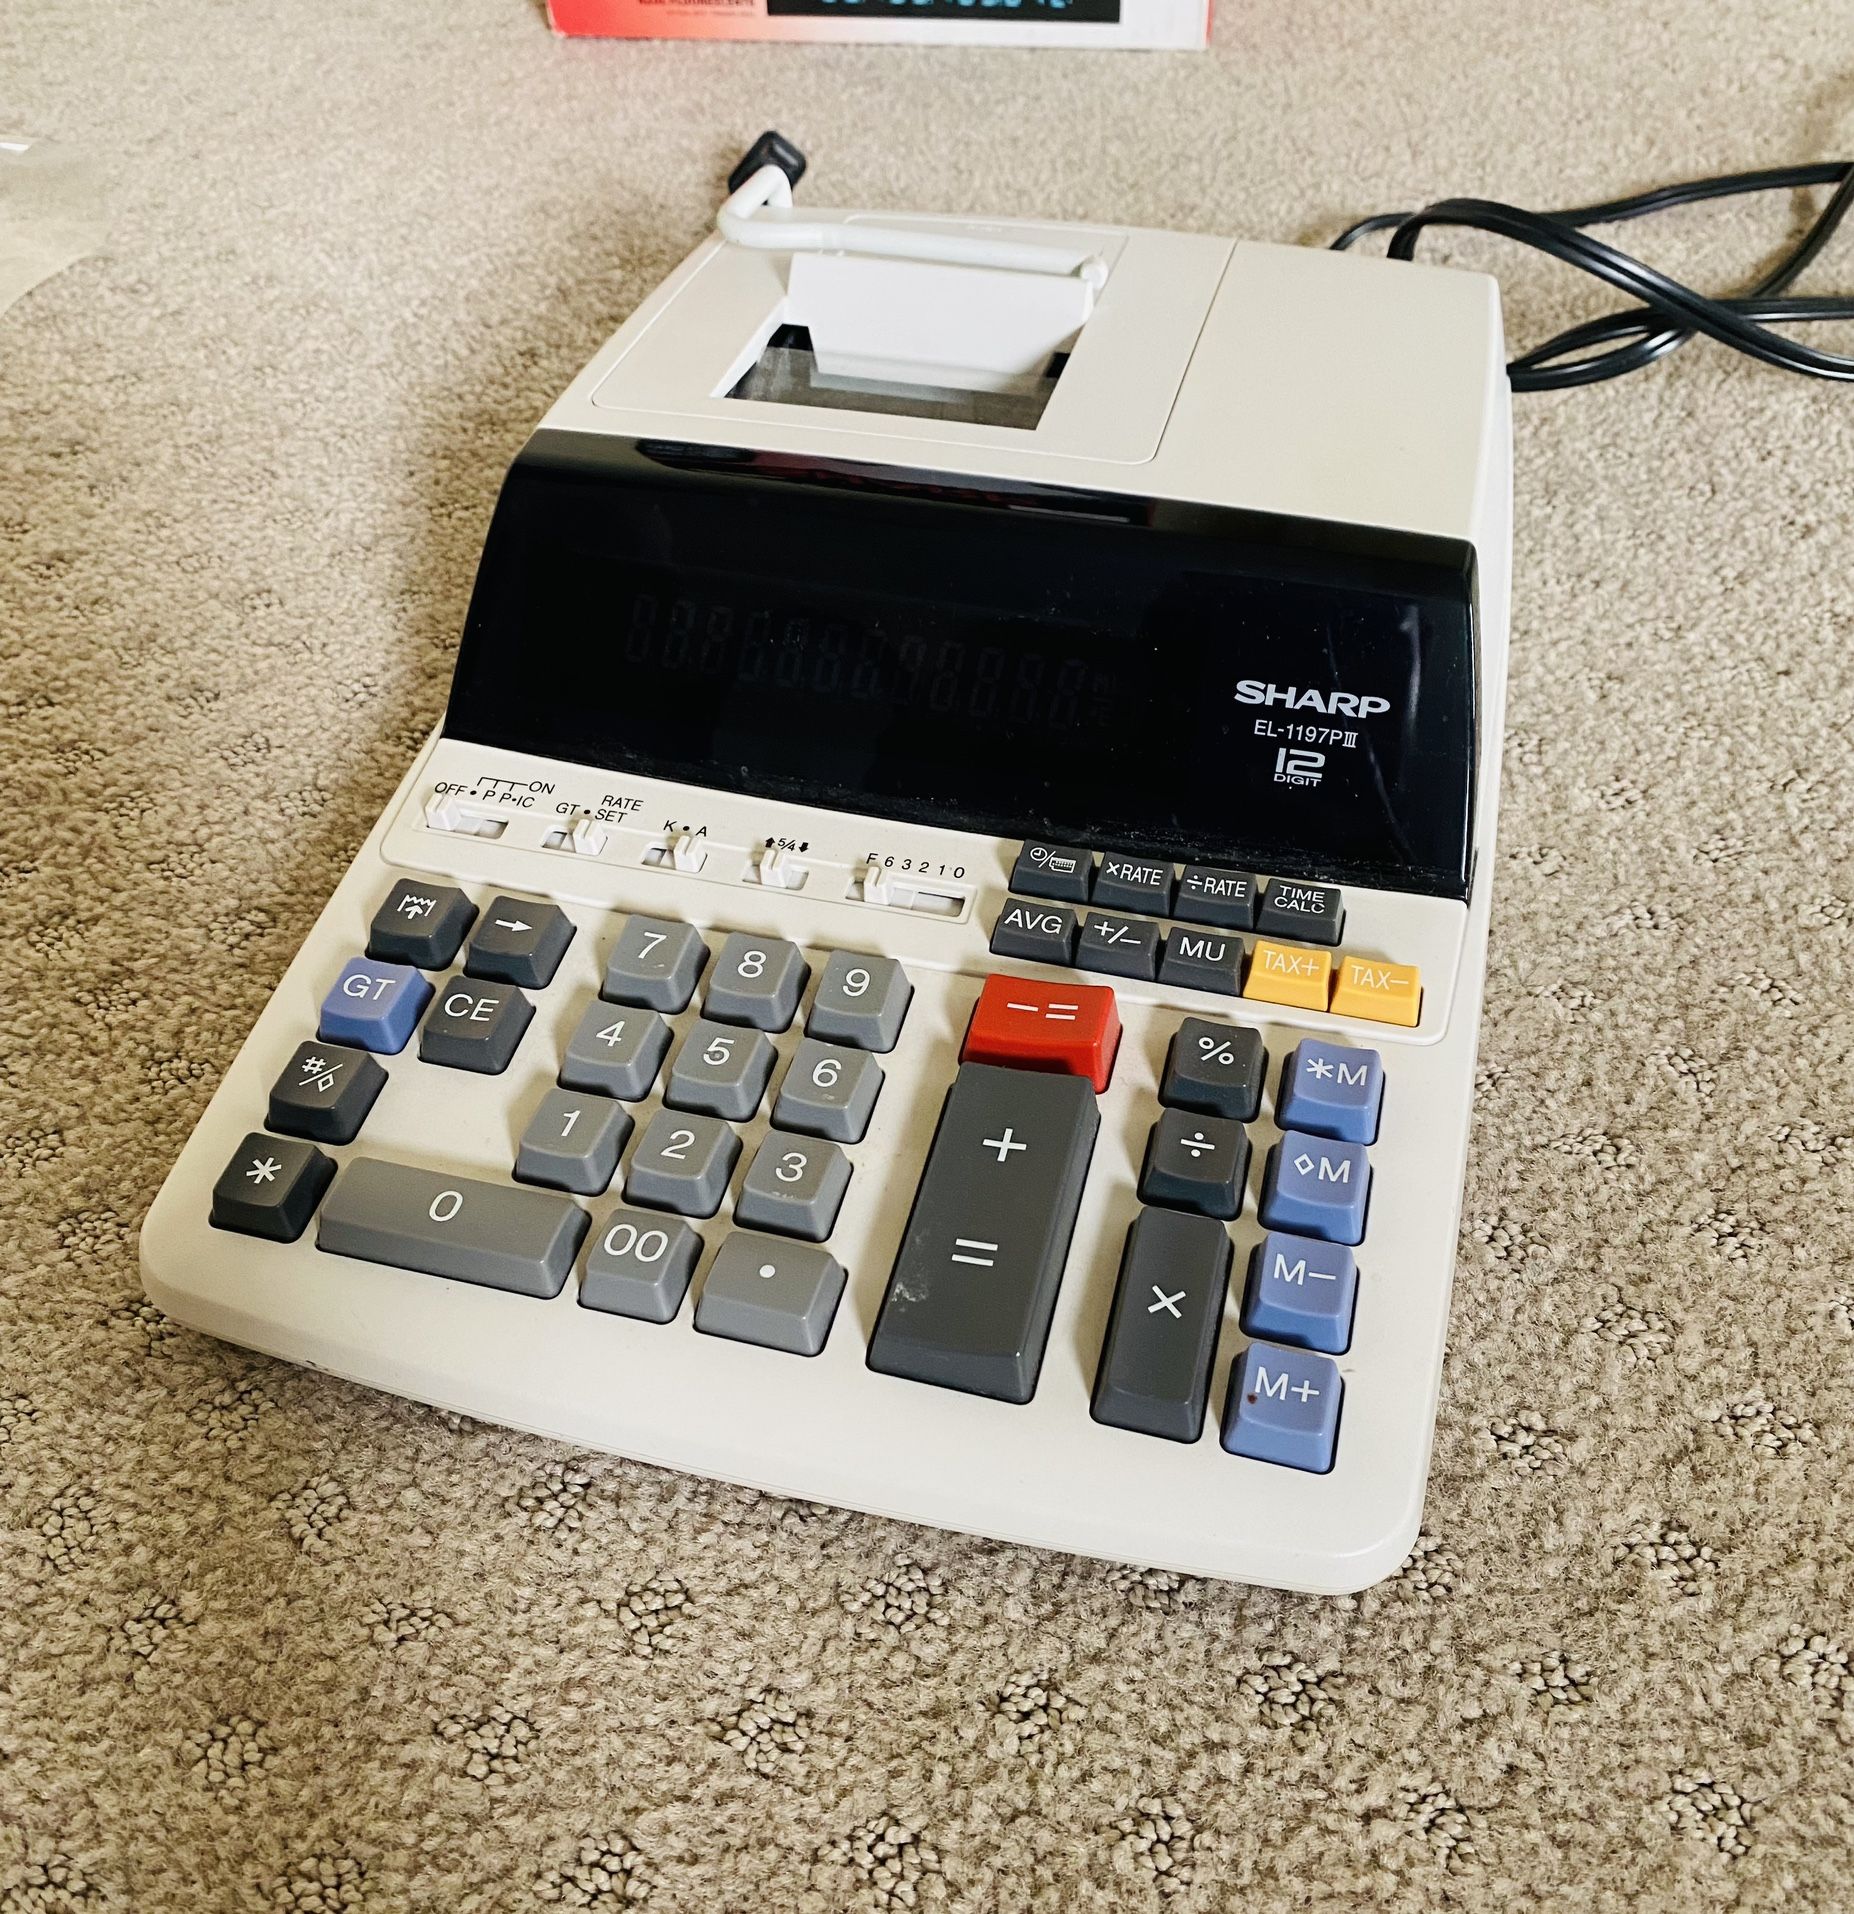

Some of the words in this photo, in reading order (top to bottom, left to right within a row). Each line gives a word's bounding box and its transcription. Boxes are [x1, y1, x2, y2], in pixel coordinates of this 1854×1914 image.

[1234, 680, 1391, 718] SHARP
[1275, 747, 1326, 778] 12
[434, 781, 468, 796] OFF
[528, 780, 556, 795] ON
[1273, 773, 1322, 787] DIGIT
[555, 802, 580, 816] GT
[594, 808, 628, 824] SET
[601, 794, 644, 812] RATE
[663, 820, 677, 832] K
[695, 825, 708, 837] A
[865, 852, 879, 865] F
[884, 855, 895, 868] 6
[901, 858, 912, 870] 3
[918, 861, 930, 873] 2
[1274, 895, 1325, 914] CALC
[1279, 885, 1325, 903] TIME
[1004, 908, 1063, 935] AVG
[638, 932, 667, 959] 7
[1179, 937, 1226, 962] MU
[737, 950, 767, 978] 8
[1263, 949, 1320, 978] TAX+
[342, 974, 396, 1001] GT
[842, 968, 871, 997] 9
[444, 993, 500, 1022] CE
[595, 1020, 626, 1047] 4
[702, 1037, 735, 1065] 5
[1198, 1036, 1234, 1065] %
[811, 1058, 842, 1087] 6
[560, 1110, 582, 1137] 1
[660, 1130, 696, 1160] 2
[775, 1152, 807, 1182] 3
[428, 1190, 464, 1222] 0
[1254, 1366, 1320, 1403] M+
